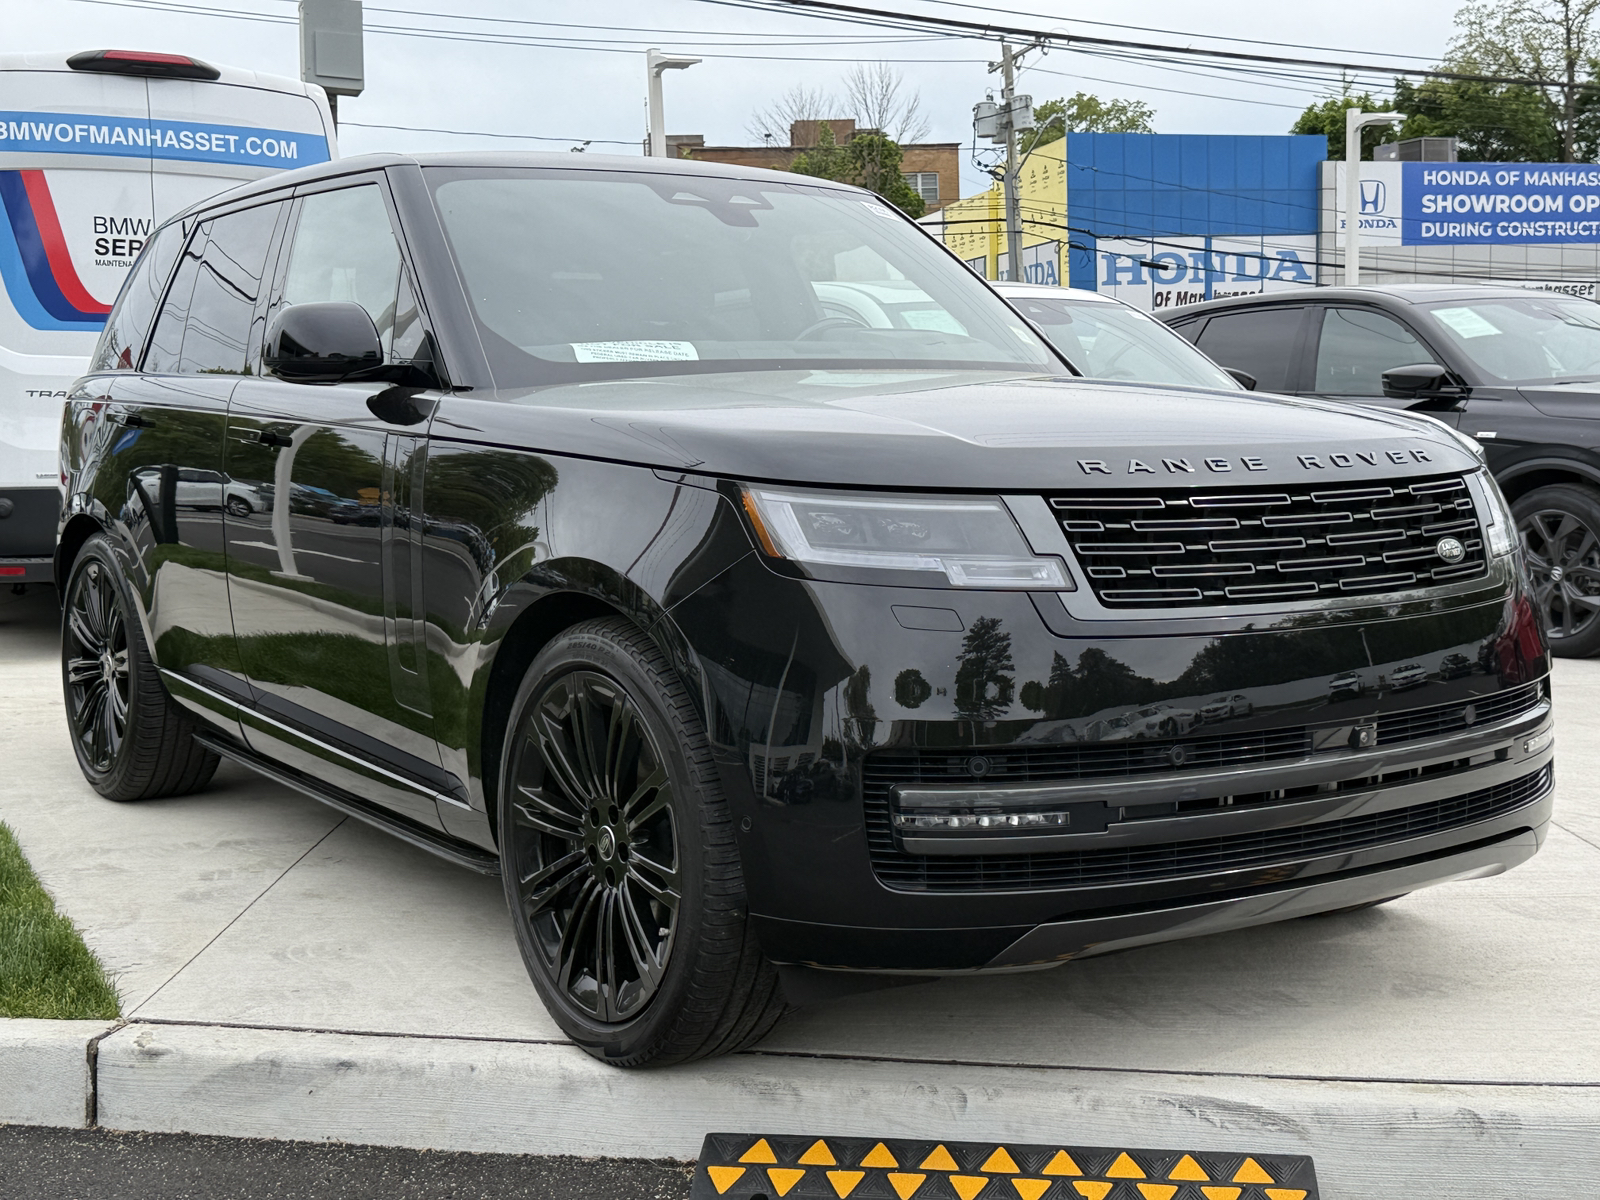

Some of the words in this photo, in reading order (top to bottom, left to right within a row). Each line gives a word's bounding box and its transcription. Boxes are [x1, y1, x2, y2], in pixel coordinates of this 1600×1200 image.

[0, 121, 298, 159] BMWOFMANHASSET.COM
[1423, 170, 1491, 186] HONDA
[1495, 170, 1520, 186] OF
[1524, 171, 1600, 186] MANHAS
[1421, 194, 1563, 213] SHOWROOM
[1569, 194, 1600, 213] OP
[93, 216, 151, 236] BMW
[1421, 222, 1492, 237] DURING
[1496, 221, 1600, 236] CONSTRUCT
[1101, 250, 1312, 286] HONDA
[1155, 290, 1171, 307] Of
[1076, 456, 1268, 475] RANGE
[1296, 449, 1433, 470] ROVER
